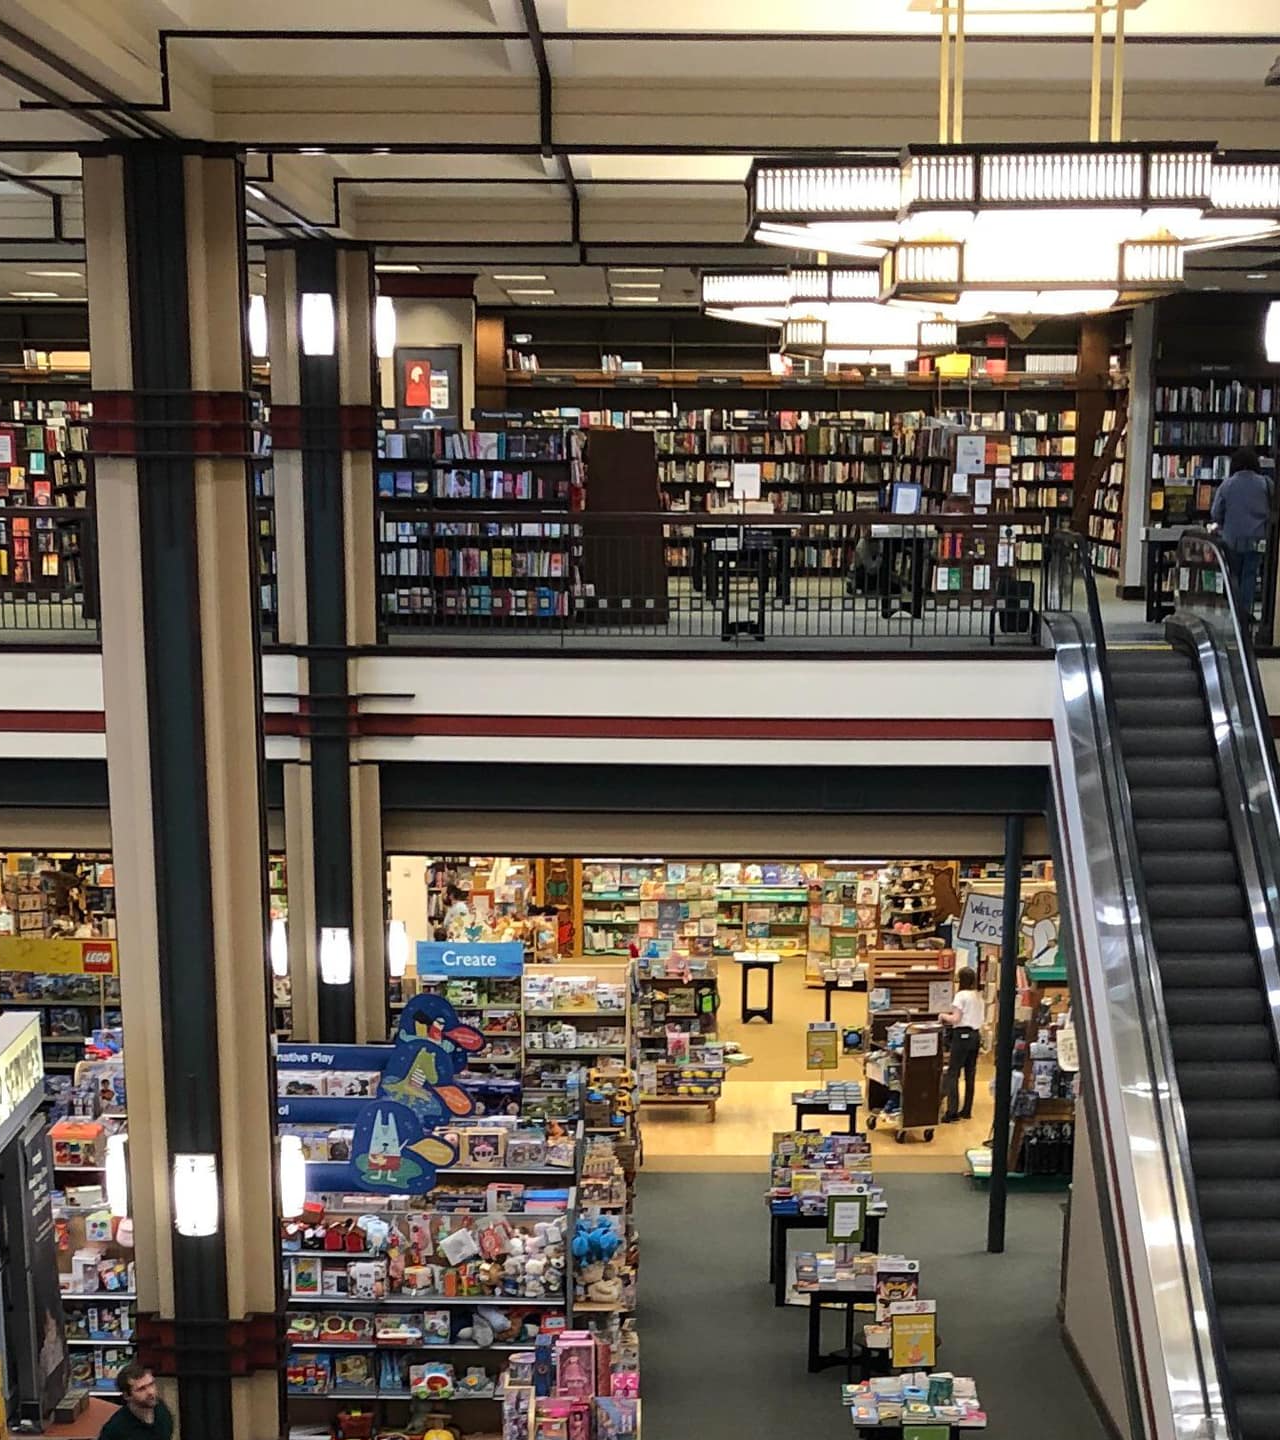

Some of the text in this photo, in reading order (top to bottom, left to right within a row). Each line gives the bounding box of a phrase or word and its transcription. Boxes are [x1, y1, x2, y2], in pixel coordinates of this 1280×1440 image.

[85, 951, 110, 963] LEGO
[441, 949, 497, 967] Create
[311, 1051, 336, 1065] Play
